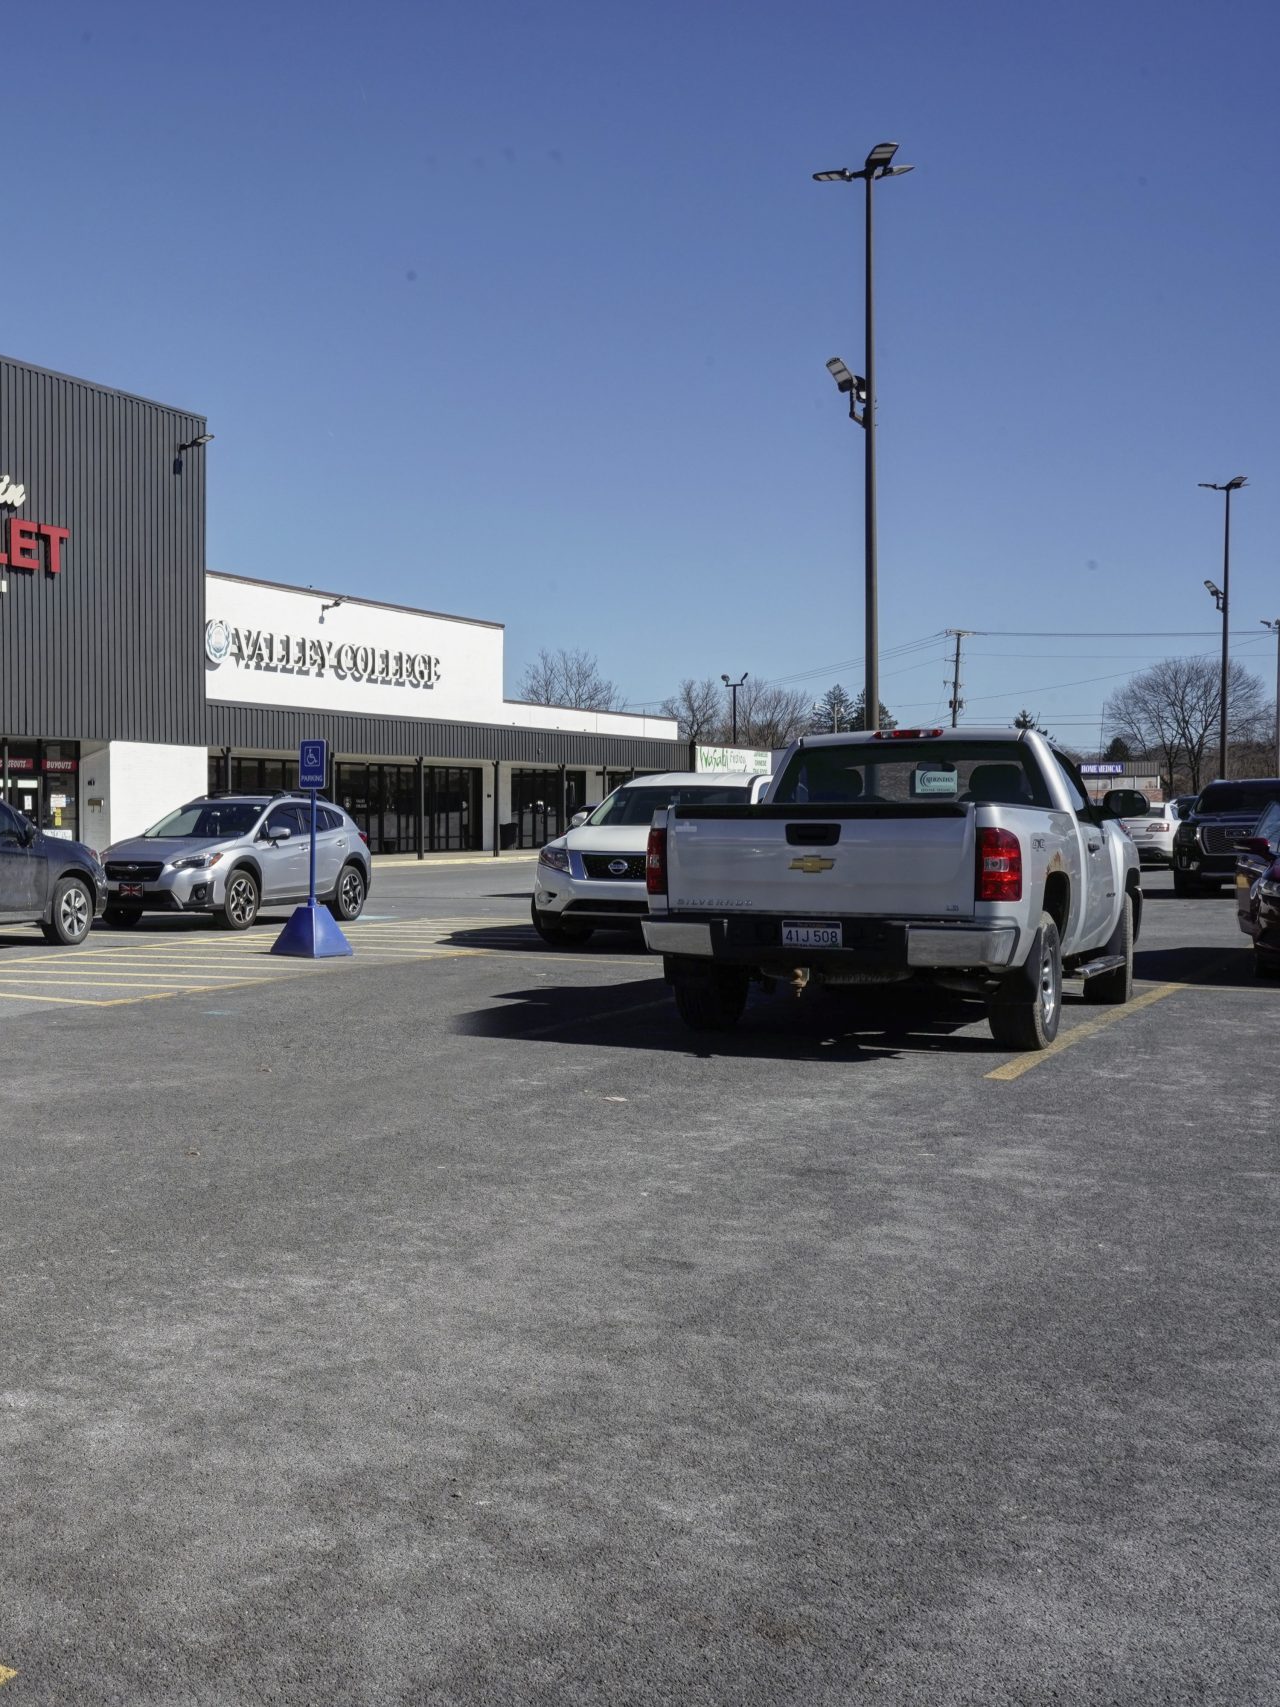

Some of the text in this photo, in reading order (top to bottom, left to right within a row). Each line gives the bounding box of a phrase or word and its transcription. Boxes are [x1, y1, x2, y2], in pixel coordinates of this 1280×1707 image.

[232, 627, 441, 684] VALLEY COLLEGE
[46, 760, 72, 769] BUYOUTS
[1081, 764, 1123, 773] HOME MEDICAL
[301, 774, 323, 782] PARKING
[785, 929, 838, 943] 41J 508
